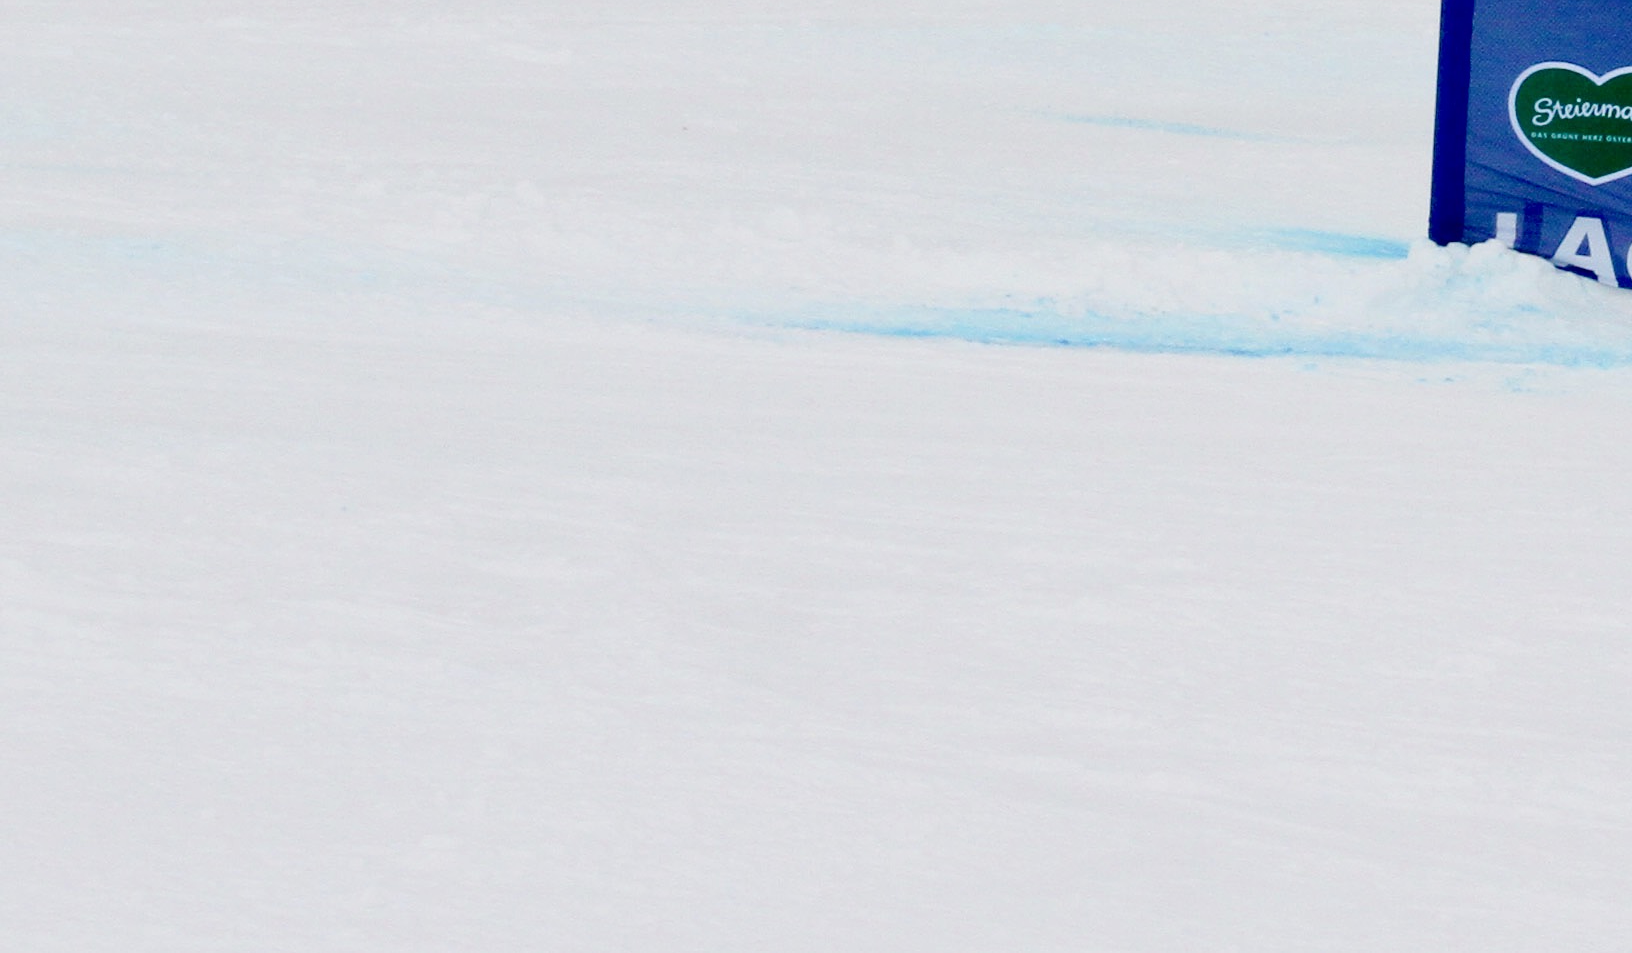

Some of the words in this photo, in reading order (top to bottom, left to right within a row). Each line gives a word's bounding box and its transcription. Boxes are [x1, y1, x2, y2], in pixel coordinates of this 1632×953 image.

[1531, 131, 1548, 139] DAS
[1551, 131, 1579, 141] GRÜNE
[1582, 133, 1603, 142] HERZ
